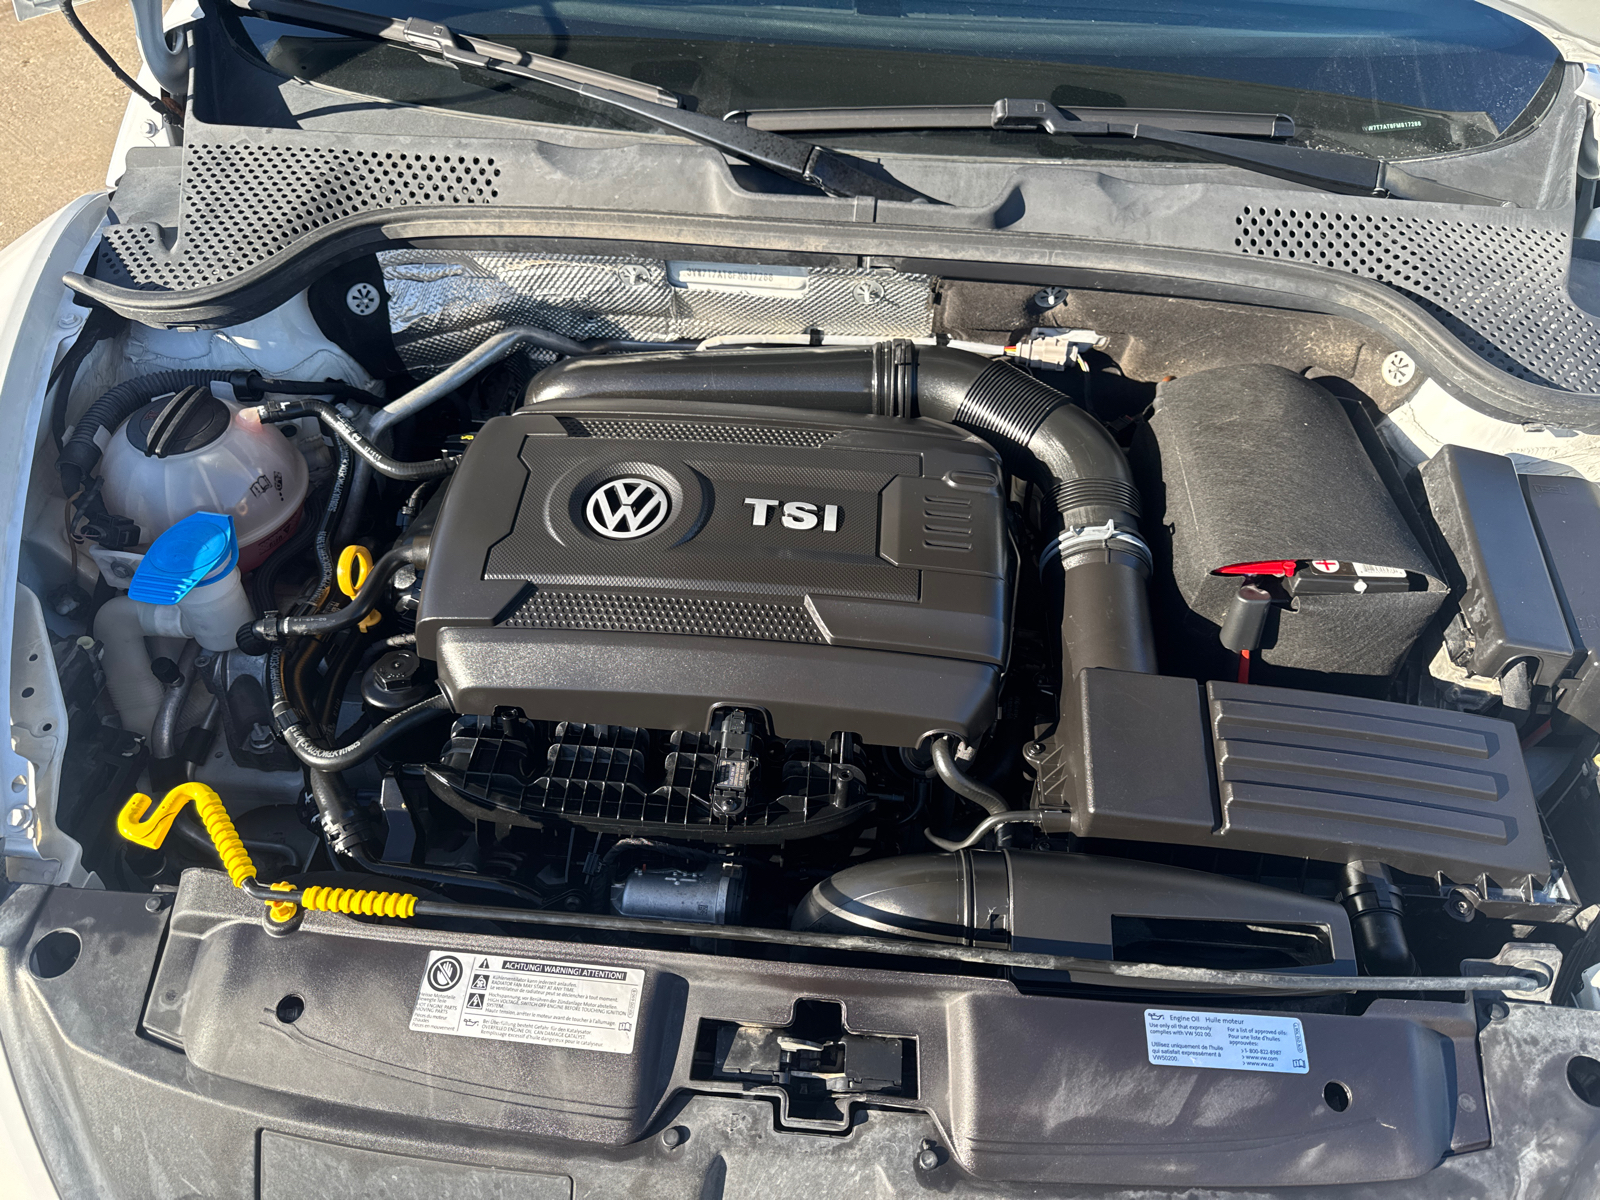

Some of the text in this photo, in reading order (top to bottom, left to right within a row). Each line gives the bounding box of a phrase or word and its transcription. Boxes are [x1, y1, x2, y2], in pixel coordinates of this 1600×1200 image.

[585, 478, 668, 539] VW
[744, 497, 838, 532] TSI
[505, 962, 624, 980] ACHTUNG! WARNING! ATTENTION!
[1170, 1014, 1190, 1023] Engine
[1255, 1028, 1277, 1036] approved
